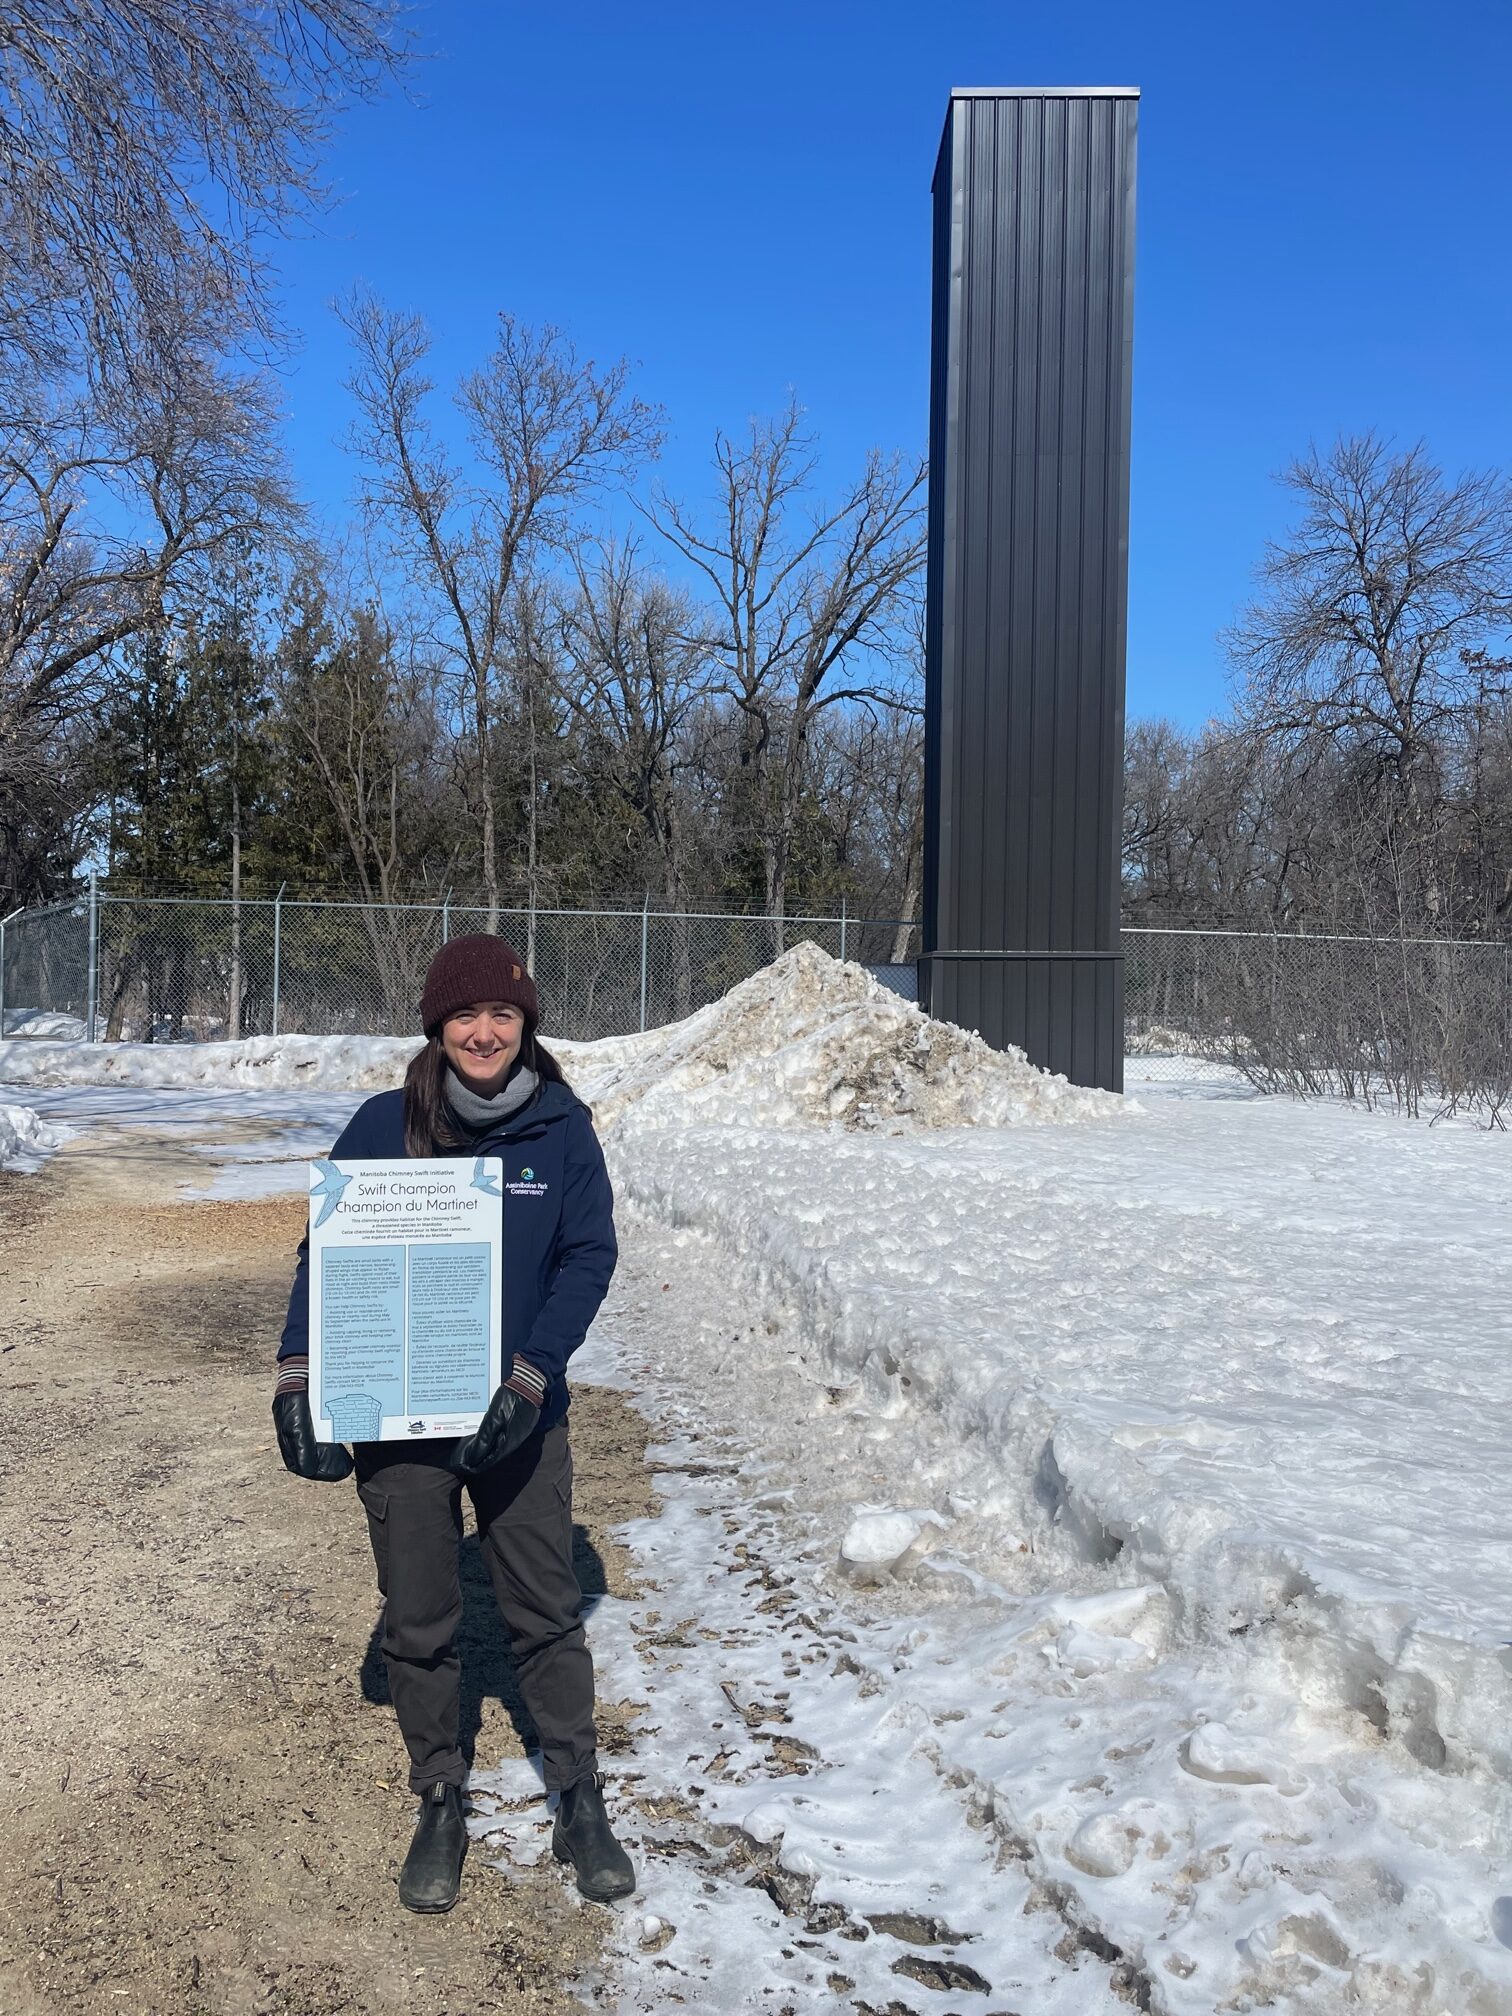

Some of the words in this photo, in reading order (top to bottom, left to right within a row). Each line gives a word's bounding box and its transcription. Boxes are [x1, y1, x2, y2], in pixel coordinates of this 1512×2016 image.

[388, 1170, 413, 1178] Chimney
[358, 1183, 386, 1196] Swift
[390, 1182, 456, 1198] Champion
[335, 1200, 401, 1215] Champion
[405, 1200, 422, 1212] du
[426, 1198, 478, 1211] Martinet
